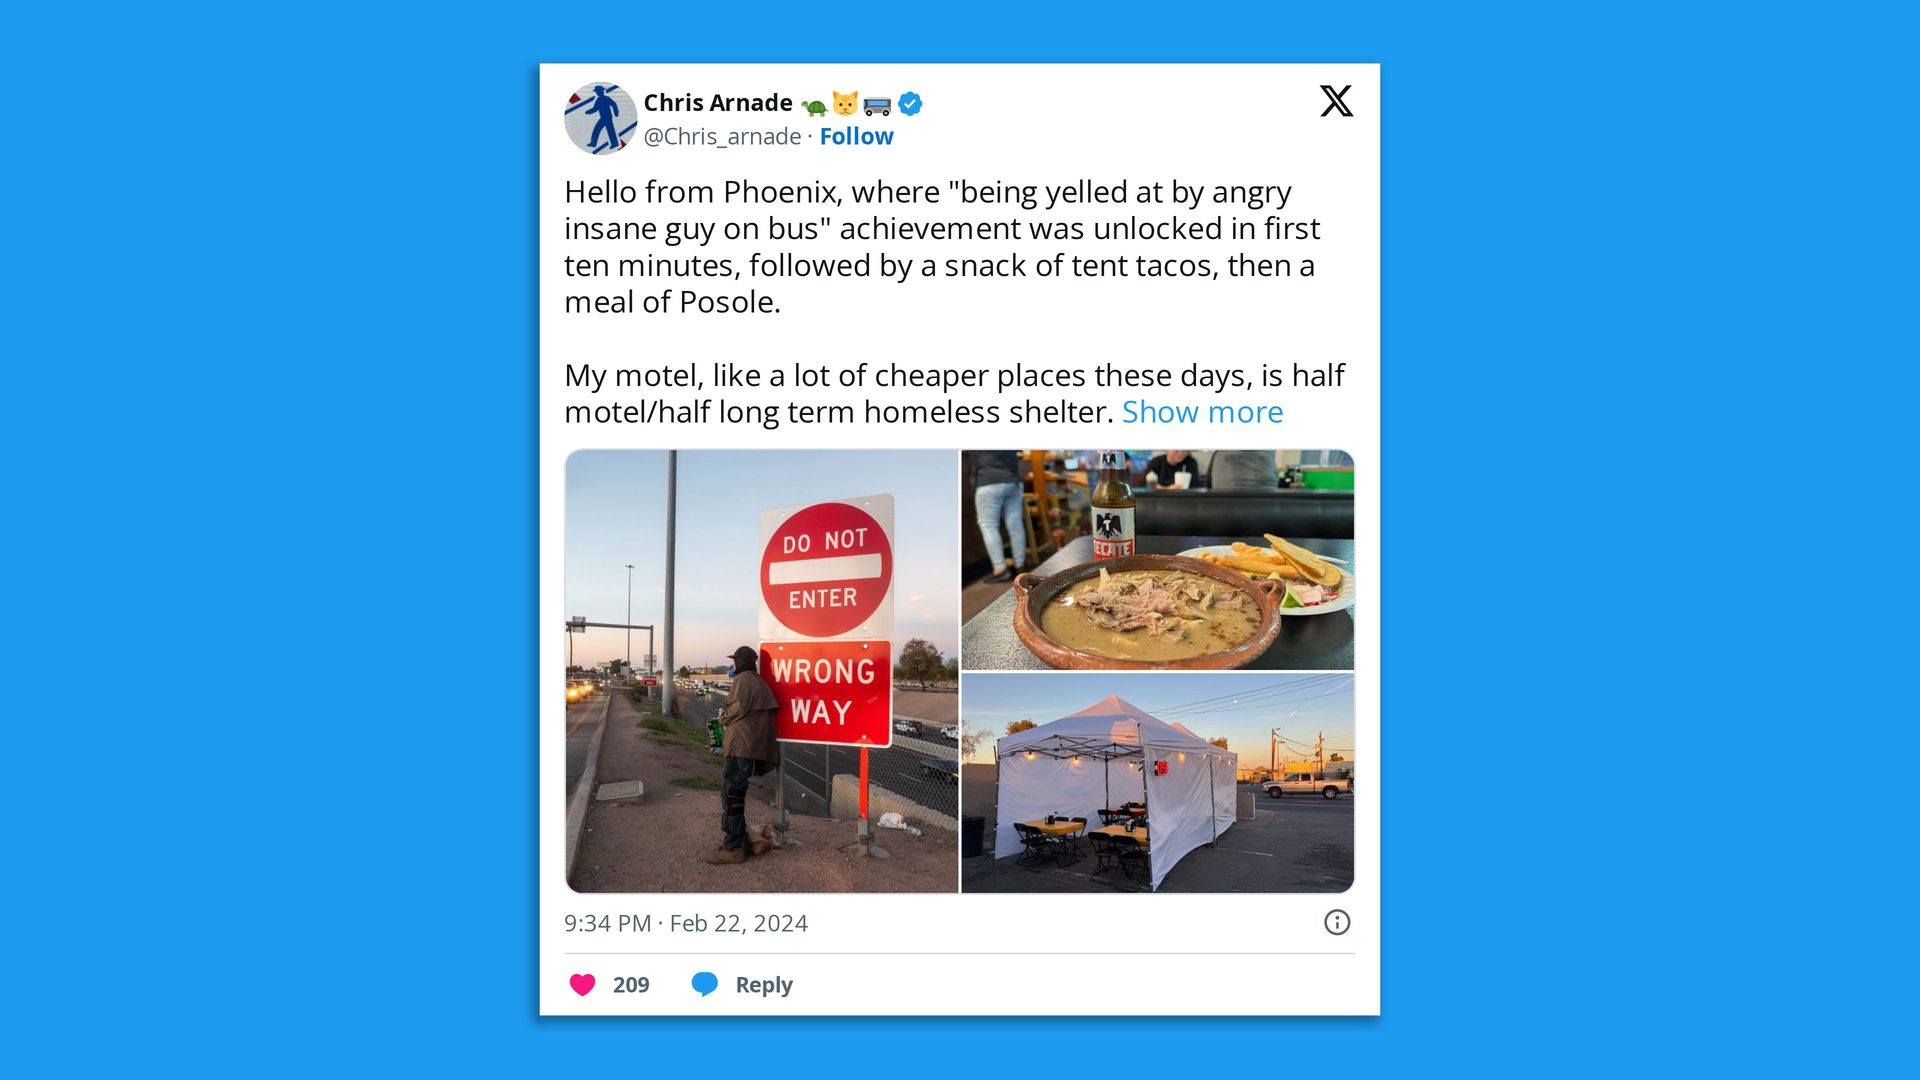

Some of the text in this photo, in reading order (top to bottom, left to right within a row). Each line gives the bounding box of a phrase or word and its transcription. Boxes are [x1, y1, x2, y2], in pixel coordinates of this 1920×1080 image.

[783, 527, 868, 554] DO NOT
[1094, 541, 1131, 558] ECATE
[789, 587, 857, 609] ENTER
[773, 658, 875, 685] WRONG
[791, 698, 853, 726] WAY
